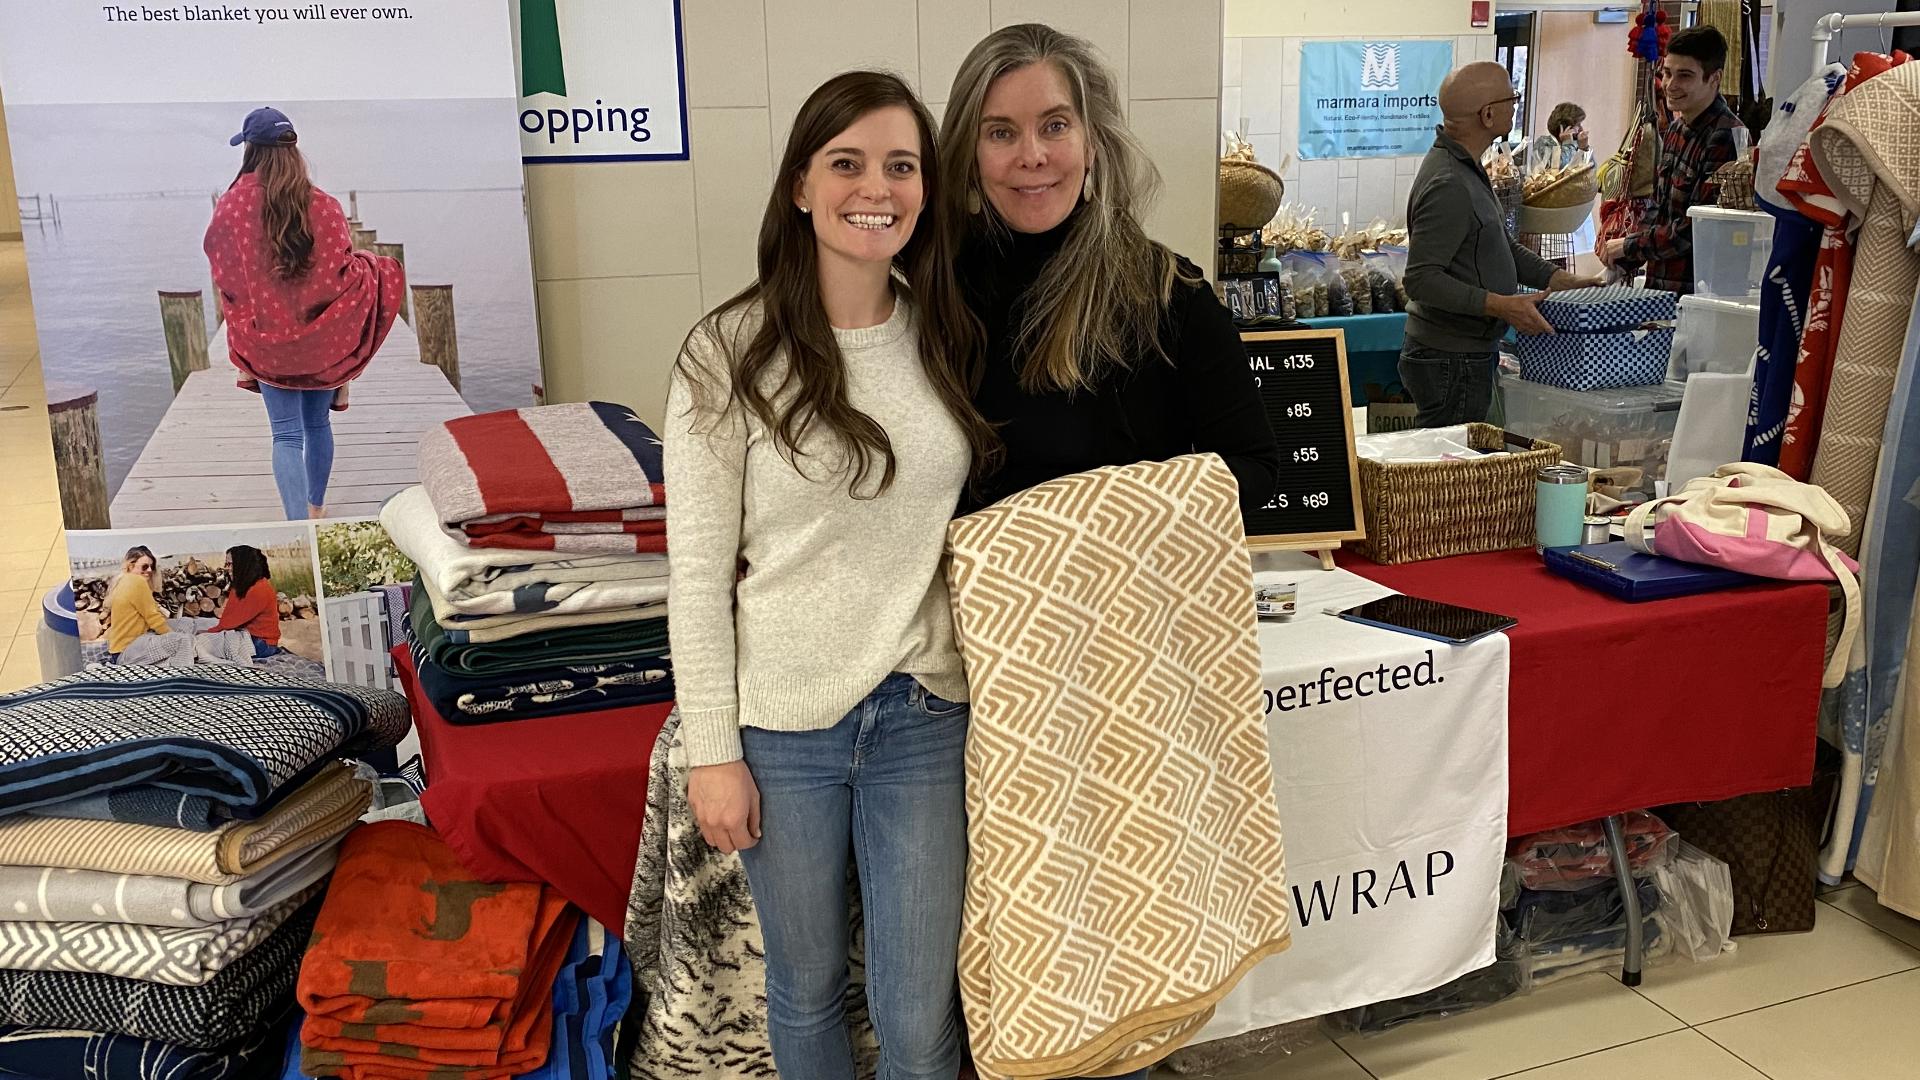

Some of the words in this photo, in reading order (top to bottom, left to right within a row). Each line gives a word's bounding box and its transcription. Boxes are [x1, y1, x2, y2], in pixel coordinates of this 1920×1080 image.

[103, 6, 138, 22] The
[143, 6, 181, 22] best
[184, 5, 251, 21] blanket
[255, 8, 289, 24] you
[293, 4, 326, 20] will
[330, 8, 368, 20] ever
[371, 7, 413, 20] own.
[1316, 97, 1379, 109] marmara
[1383, 93, 1438, 111] imports
[519, 96, 651, 143] opping
[1283, 355, 1314, 369] $135
[1287, 403, 1312, 417] $85
[1293, 447, 1319, 463] $55
[1302, 492, 1329, 508] $69
[1292, 850, 1454, 927] WRAP
